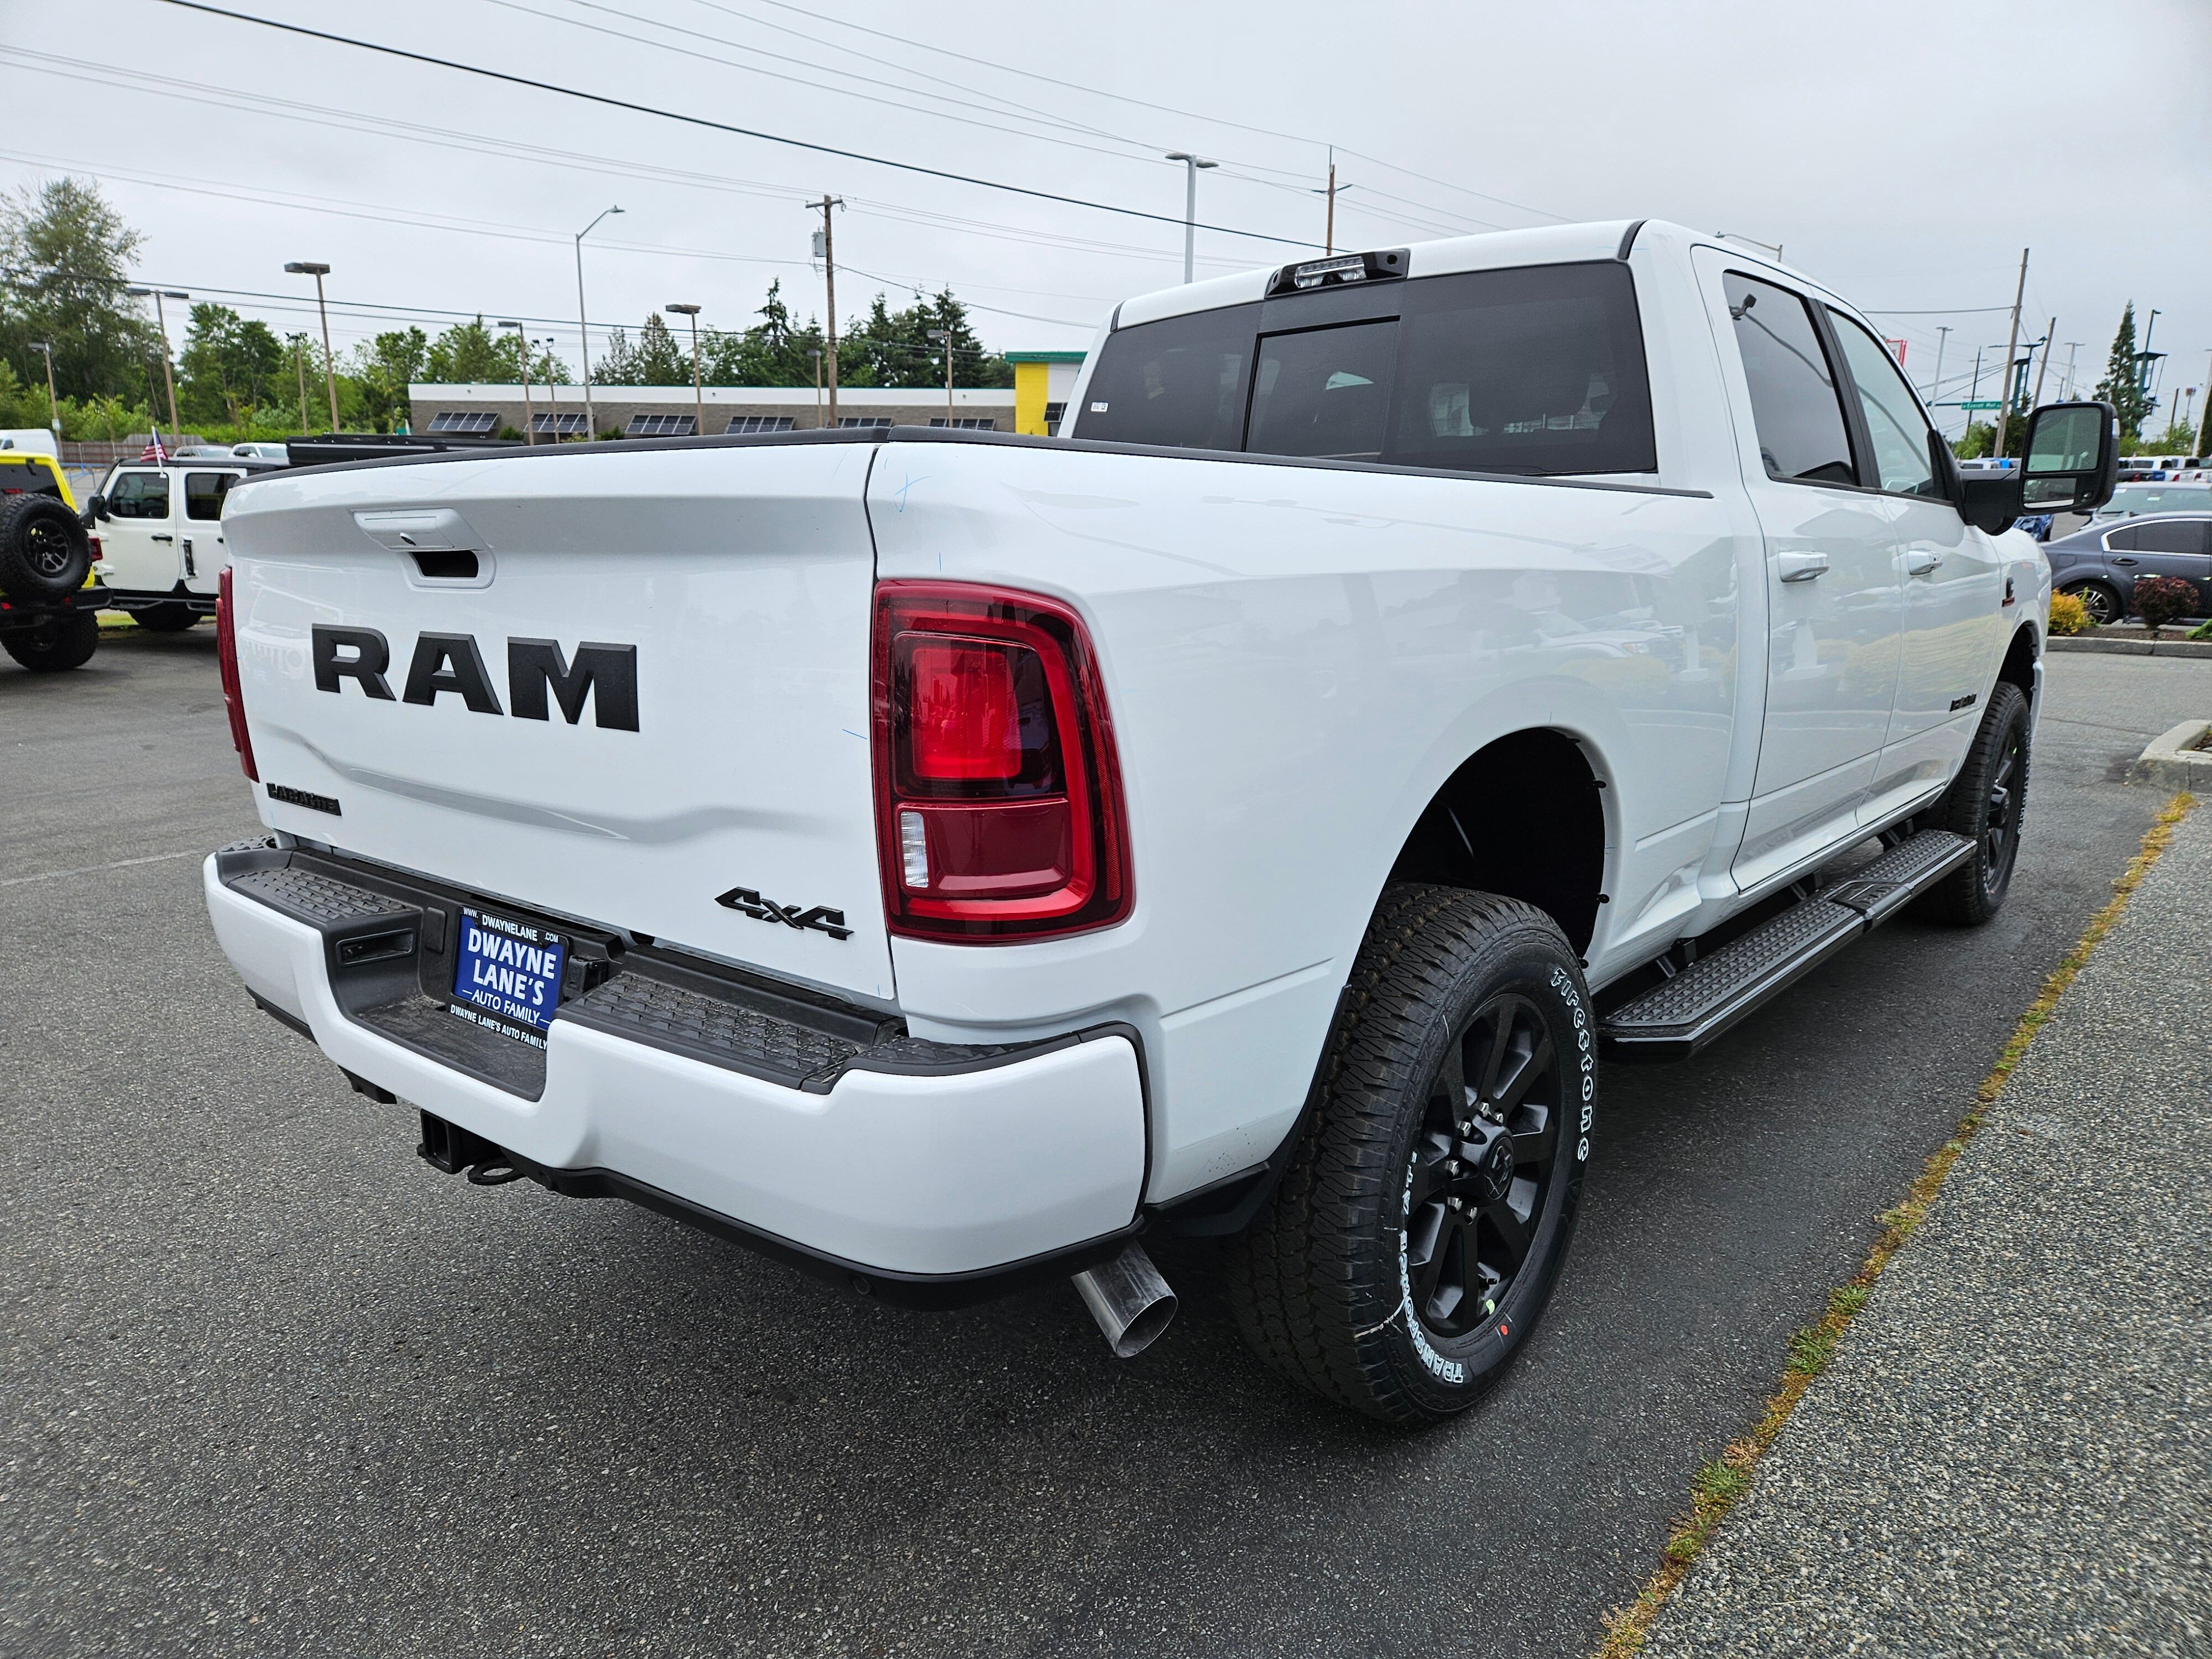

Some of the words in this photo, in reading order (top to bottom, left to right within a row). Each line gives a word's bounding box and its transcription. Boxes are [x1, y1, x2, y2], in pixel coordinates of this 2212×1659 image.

[312, 623, 639, 732] RAM
[482, 915, 538, 941] DWAYNELANE
[544, 932, 559, 943] .COM
[468, 927, 557, 979] DWAYNE
[473, 959, 545, 1005] LANE'S
[450, 1004, 477, 1022] DWAYNE
[478, 1013, 500, 1032] LANE'S
[502, 1024, 520, 1040] AUTO
[521, 1032, 547, 1050] FAMILY
[471, 989, 501, 1010] AUTO
[503, 1000, 540, 1025] FAMILY
[1551, 968, 1594, 1161] Firestone
